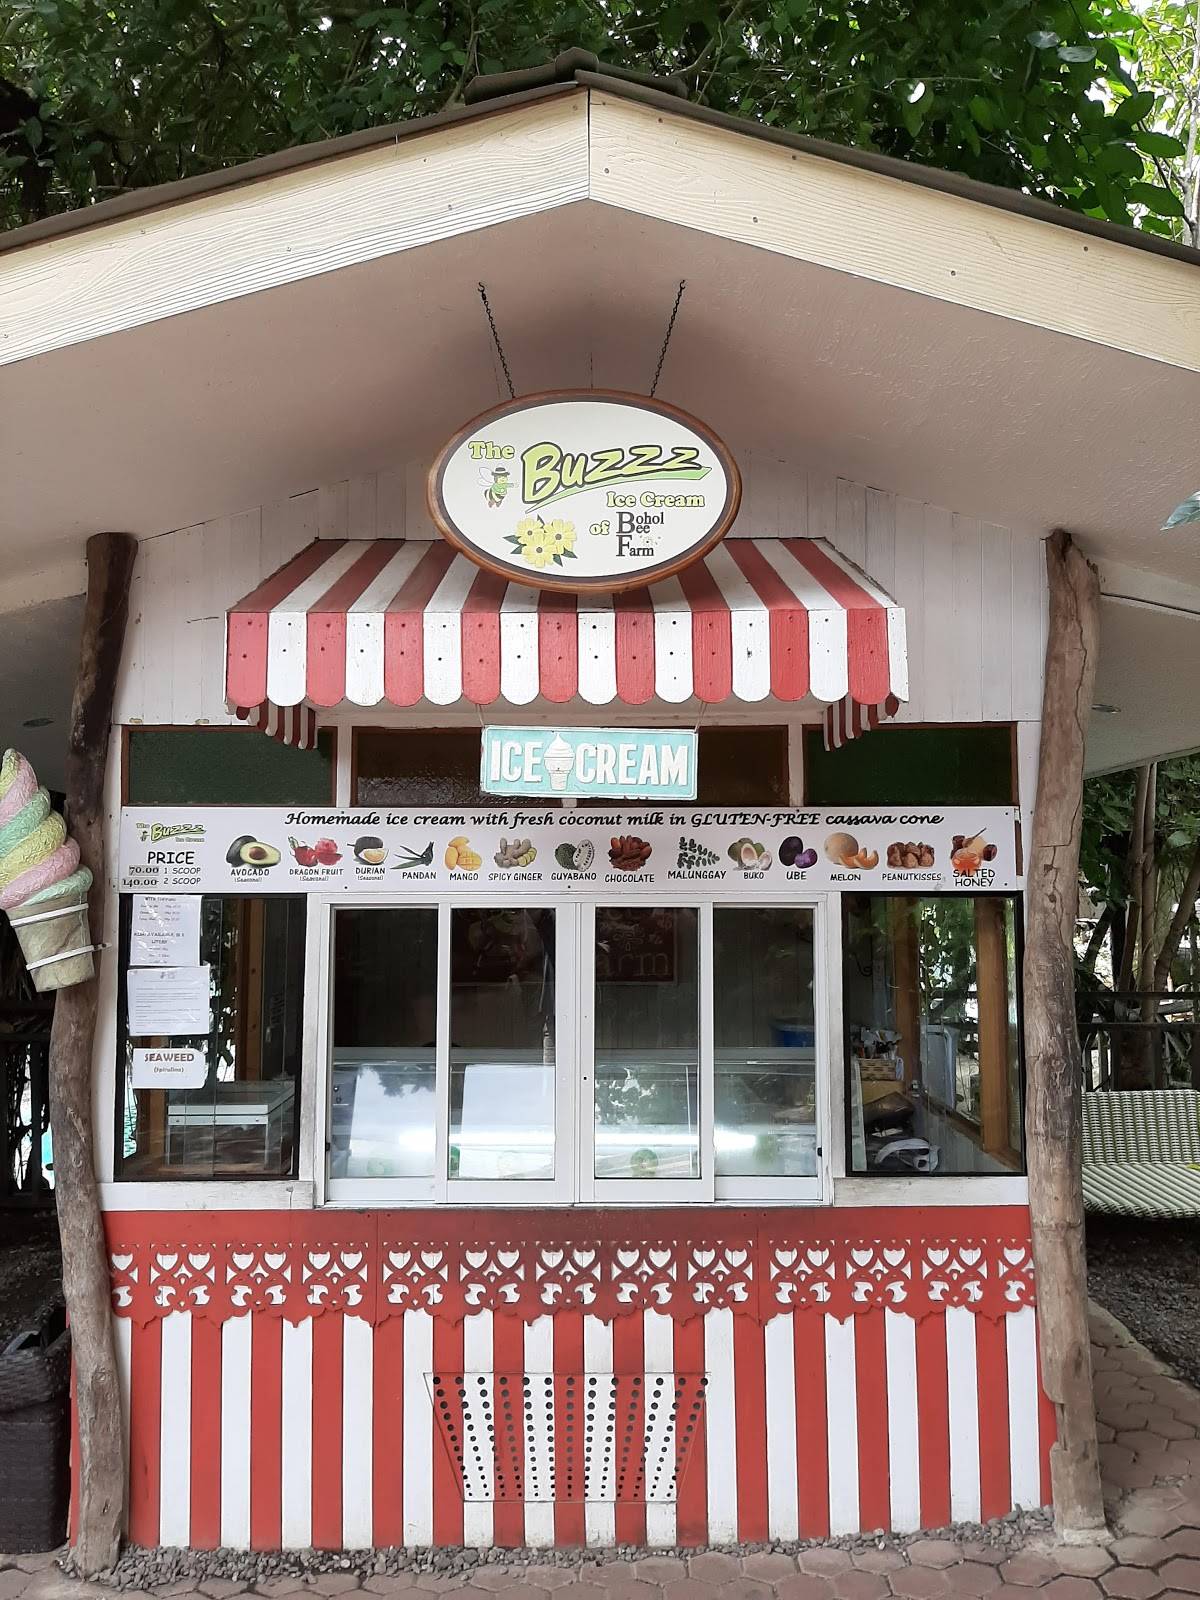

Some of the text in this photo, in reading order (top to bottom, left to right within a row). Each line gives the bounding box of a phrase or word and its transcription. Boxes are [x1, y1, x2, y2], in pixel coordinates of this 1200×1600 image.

[468, 441, 702, 504] The Buzzz
[606, 491, 705, 507] Ice Cream
[589, 511, 665, 535] of Bohol
[616, 534, 654, 557] Farm
[490, 739, 688, 786] ICE CREAM
[284, 811, 944, 829] Homemade ice cream with fresh coconut milk in GLUTEN-FREE cassava cone
[151, 823, 205, 841] Buzzz
[147, 851, 195, 865] PRICE
[129, 866, 201, 876] 70.00 1 SCOOP
[230, 868, 270, 876] AVOCADO
[289, 868, 345, 876] DRAGON FRUIT
[355, 867, 386, 875] DURIAN
[402, 871, 437, 880] PANDAN
[667, 870, 726, 880] MALUNGGAY
[786, 871, 807, 880] UBE
[952, 868, 995, 878] SALTED
[449, 873, 479, 881] MANGO
[488, 873, 543, 881] SPICY GINGER
[551, 872, 597, 881] GUYABANO
[604, 874, 655, 883] CHOCOLATE
[743, 872, 764, 880] BUKO
[830, 873, 861, 881] MELON
[881, 873, 942, 881] PEANUTKISSES
[163, 877, 168, 885] 2
[172, 877, 201, 885] SCOOP
[954, 878, 994, 887] HONEY
[144, 1053, 195, 1062] SEAWEED
